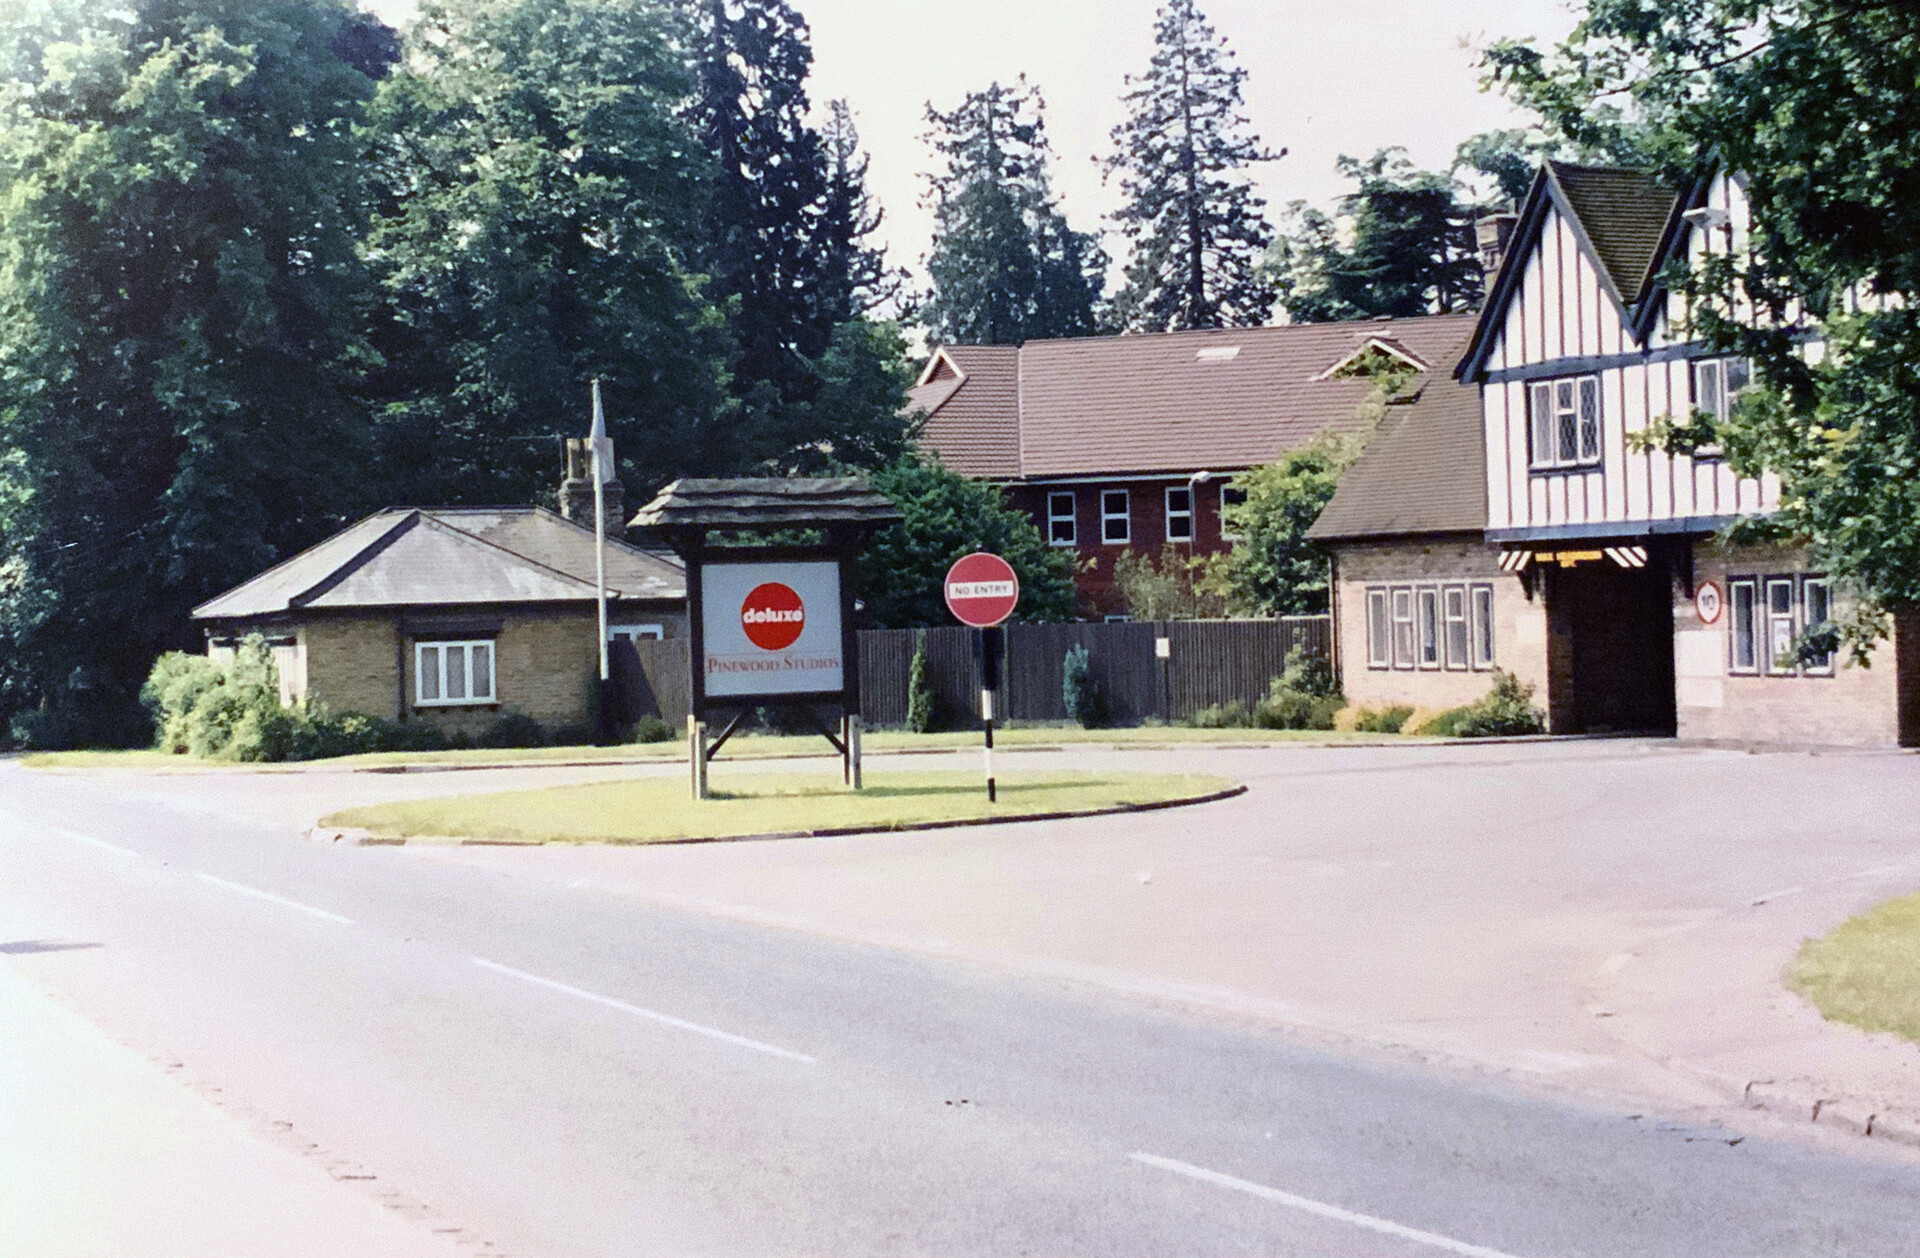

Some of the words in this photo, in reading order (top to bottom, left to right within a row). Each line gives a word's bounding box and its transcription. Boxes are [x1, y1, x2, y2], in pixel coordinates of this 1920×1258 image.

[955, 587, 970, 595] NO
[974, 585, 1007, 594] ENTRY
[743, 606, 803, 623] deluxe
[707, 658, 780, 673] PINEWOOD
[784, 656, 840, 671] STUDIOS
